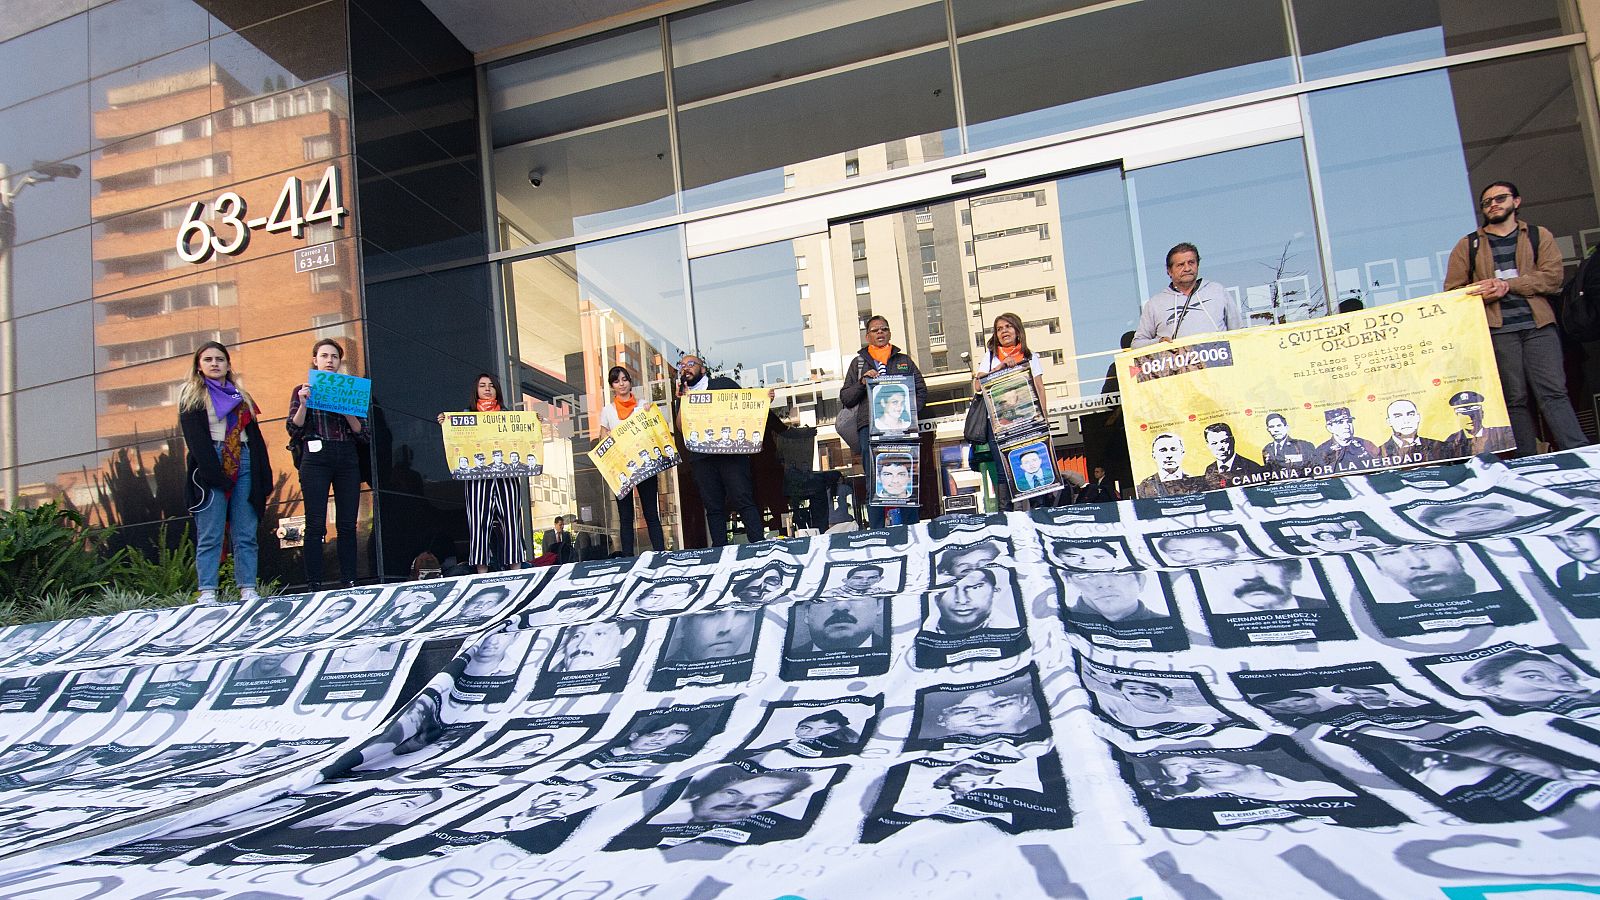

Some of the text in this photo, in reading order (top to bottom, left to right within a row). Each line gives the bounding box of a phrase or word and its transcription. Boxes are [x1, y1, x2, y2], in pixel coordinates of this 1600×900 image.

[176, 166, 346, 263] 63-44
[300, 254, 330, 269] 63-44
[1364, 312, 1404, 330] DIO
[1418, 303, 1447, 320] LA
[1321, 326, 1400, 352] ORDEN?
[1293, 342, 1455, 378] militares y civiles en el
[1310, 338, 1434, 368] Falsos positivos de
[1142, 347, 1229, 375] 08/10/2006
[1331, 358, 1416, 380] caso carvajal
[316, 373, 355, 388] 2429
[312, 384, 369, 399] ASESINATOS
[690, 393, 711, 403] 5763
[332, 396, 368, 407] CIVILES
[730, 401, 739, 411] LA
[452, 416, 476, 426] 5763
[498, 424, 508, 433] LA
[597, 438, 615, 457] 5763
[1231, 464, 1298, 486] CAMPAÑA
[1304, 464, 1333, 477] POR
[1339, 461, 1358, 472] LA
[1362, 452, 1423, 468] VERDAD
[847, 531, 890, 539] DESAPARECIDO
[1161, 528, 1210, 537] GENOCIDIO
[1226, 614, 1273, 623] HERNANDO
[1275, 612, 1309, 620] MENDEZ
[1346, 665, 1375, 673] TRIANA
[967, 795, 981, 803] DE
[992, 793, 1057, 814] DEL CHUCURI
